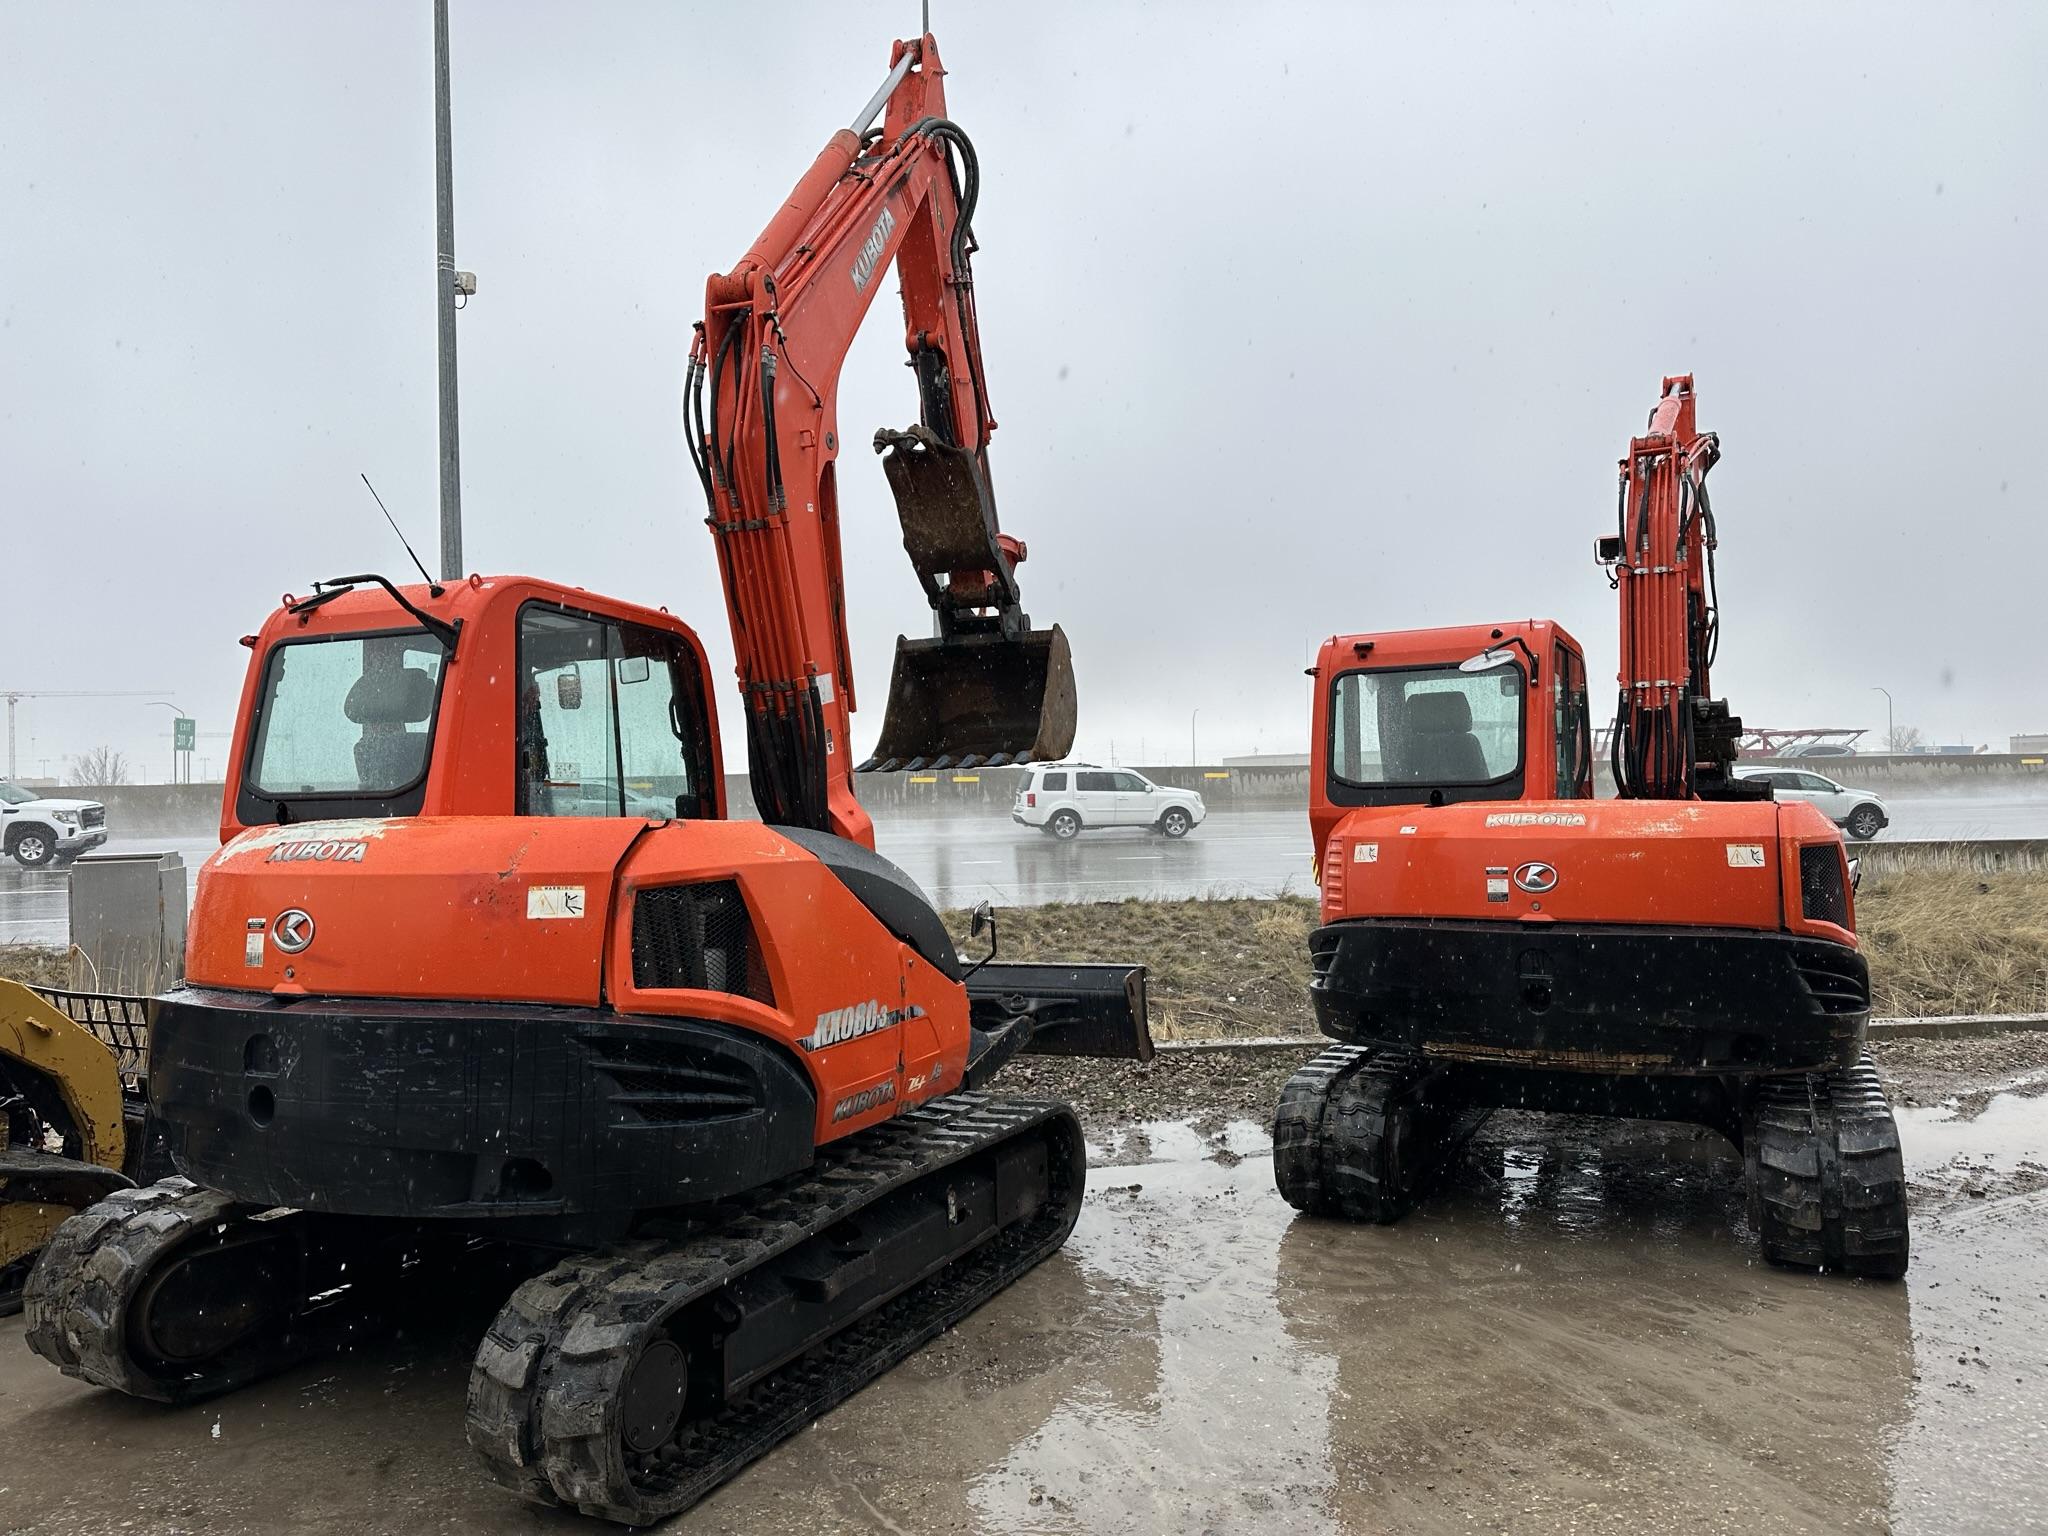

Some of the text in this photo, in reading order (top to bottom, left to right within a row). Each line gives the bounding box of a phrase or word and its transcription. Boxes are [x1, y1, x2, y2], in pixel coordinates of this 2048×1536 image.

[850, 206, 896, 296] KUBOTA
[1485, 812, 1587, 828] KUBOTA
[267, 841, 368, 862] KUBOTA
[833, 1080, 896, 1122] KUBOTA
